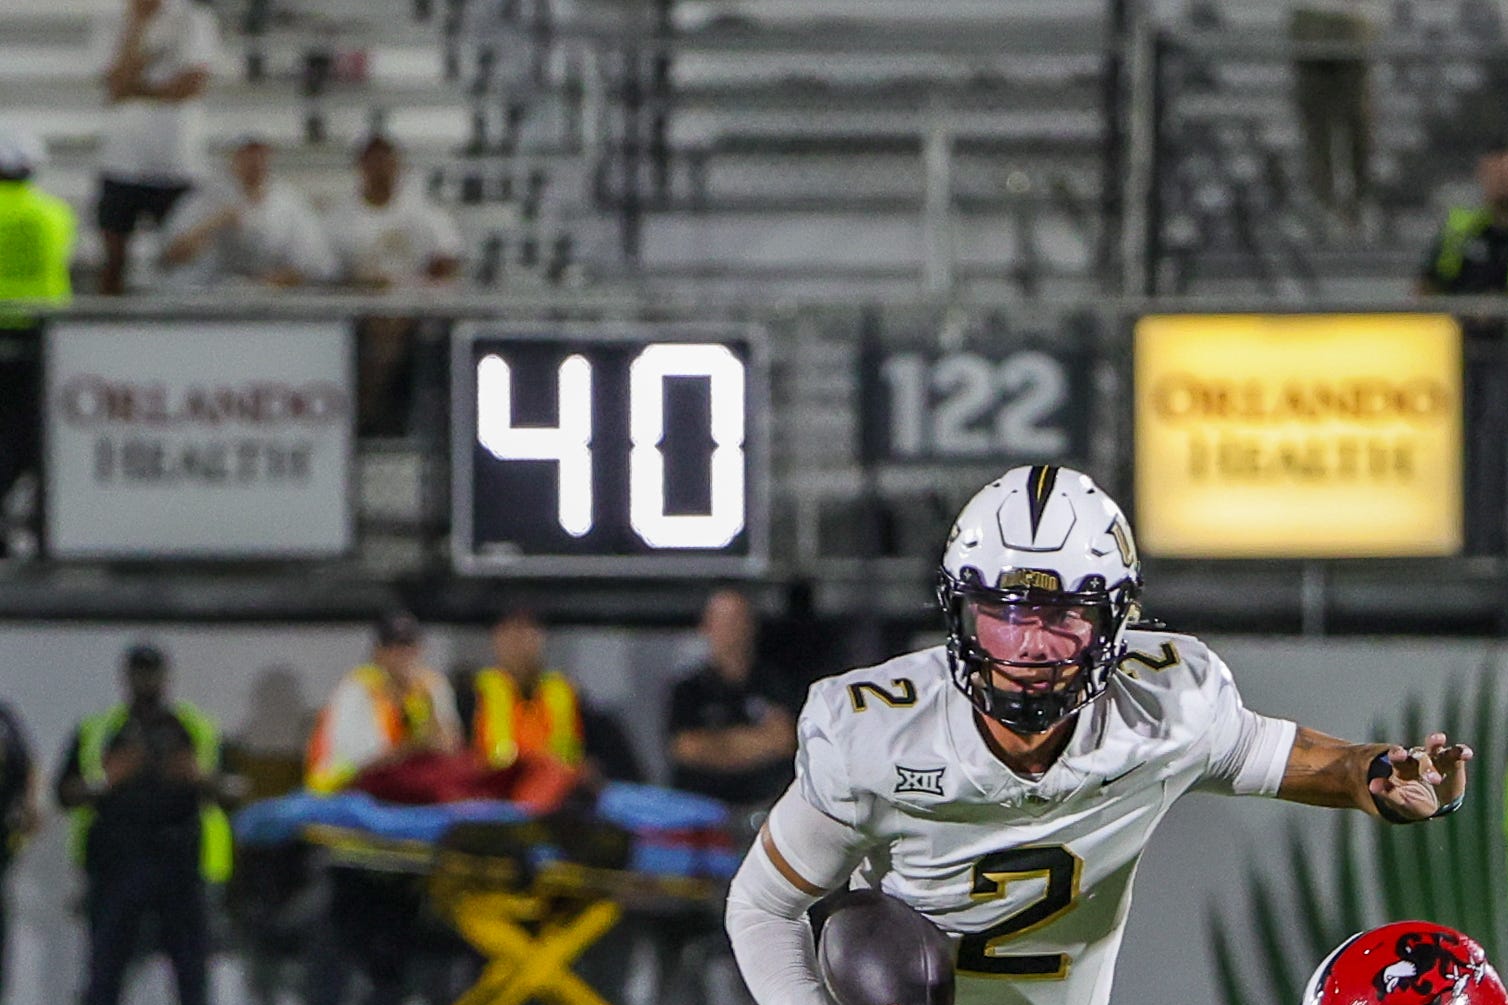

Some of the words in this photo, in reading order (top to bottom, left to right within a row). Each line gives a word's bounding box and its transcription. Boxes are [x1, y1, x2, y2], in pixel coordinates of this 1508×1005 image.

[60, 376, 348, 428] ORLANDO
[881, 350, 1071, 459] 122
[1152, 374, 1450, 427] ORLANDO
[477, 344, 746, 549] 40
[1187, 438, 1414, 484] HEALTH
[1117, 641, 1180, 679] 2
[847, 678, 918, 713] 2
[956, 844, 1084, 980] 2
